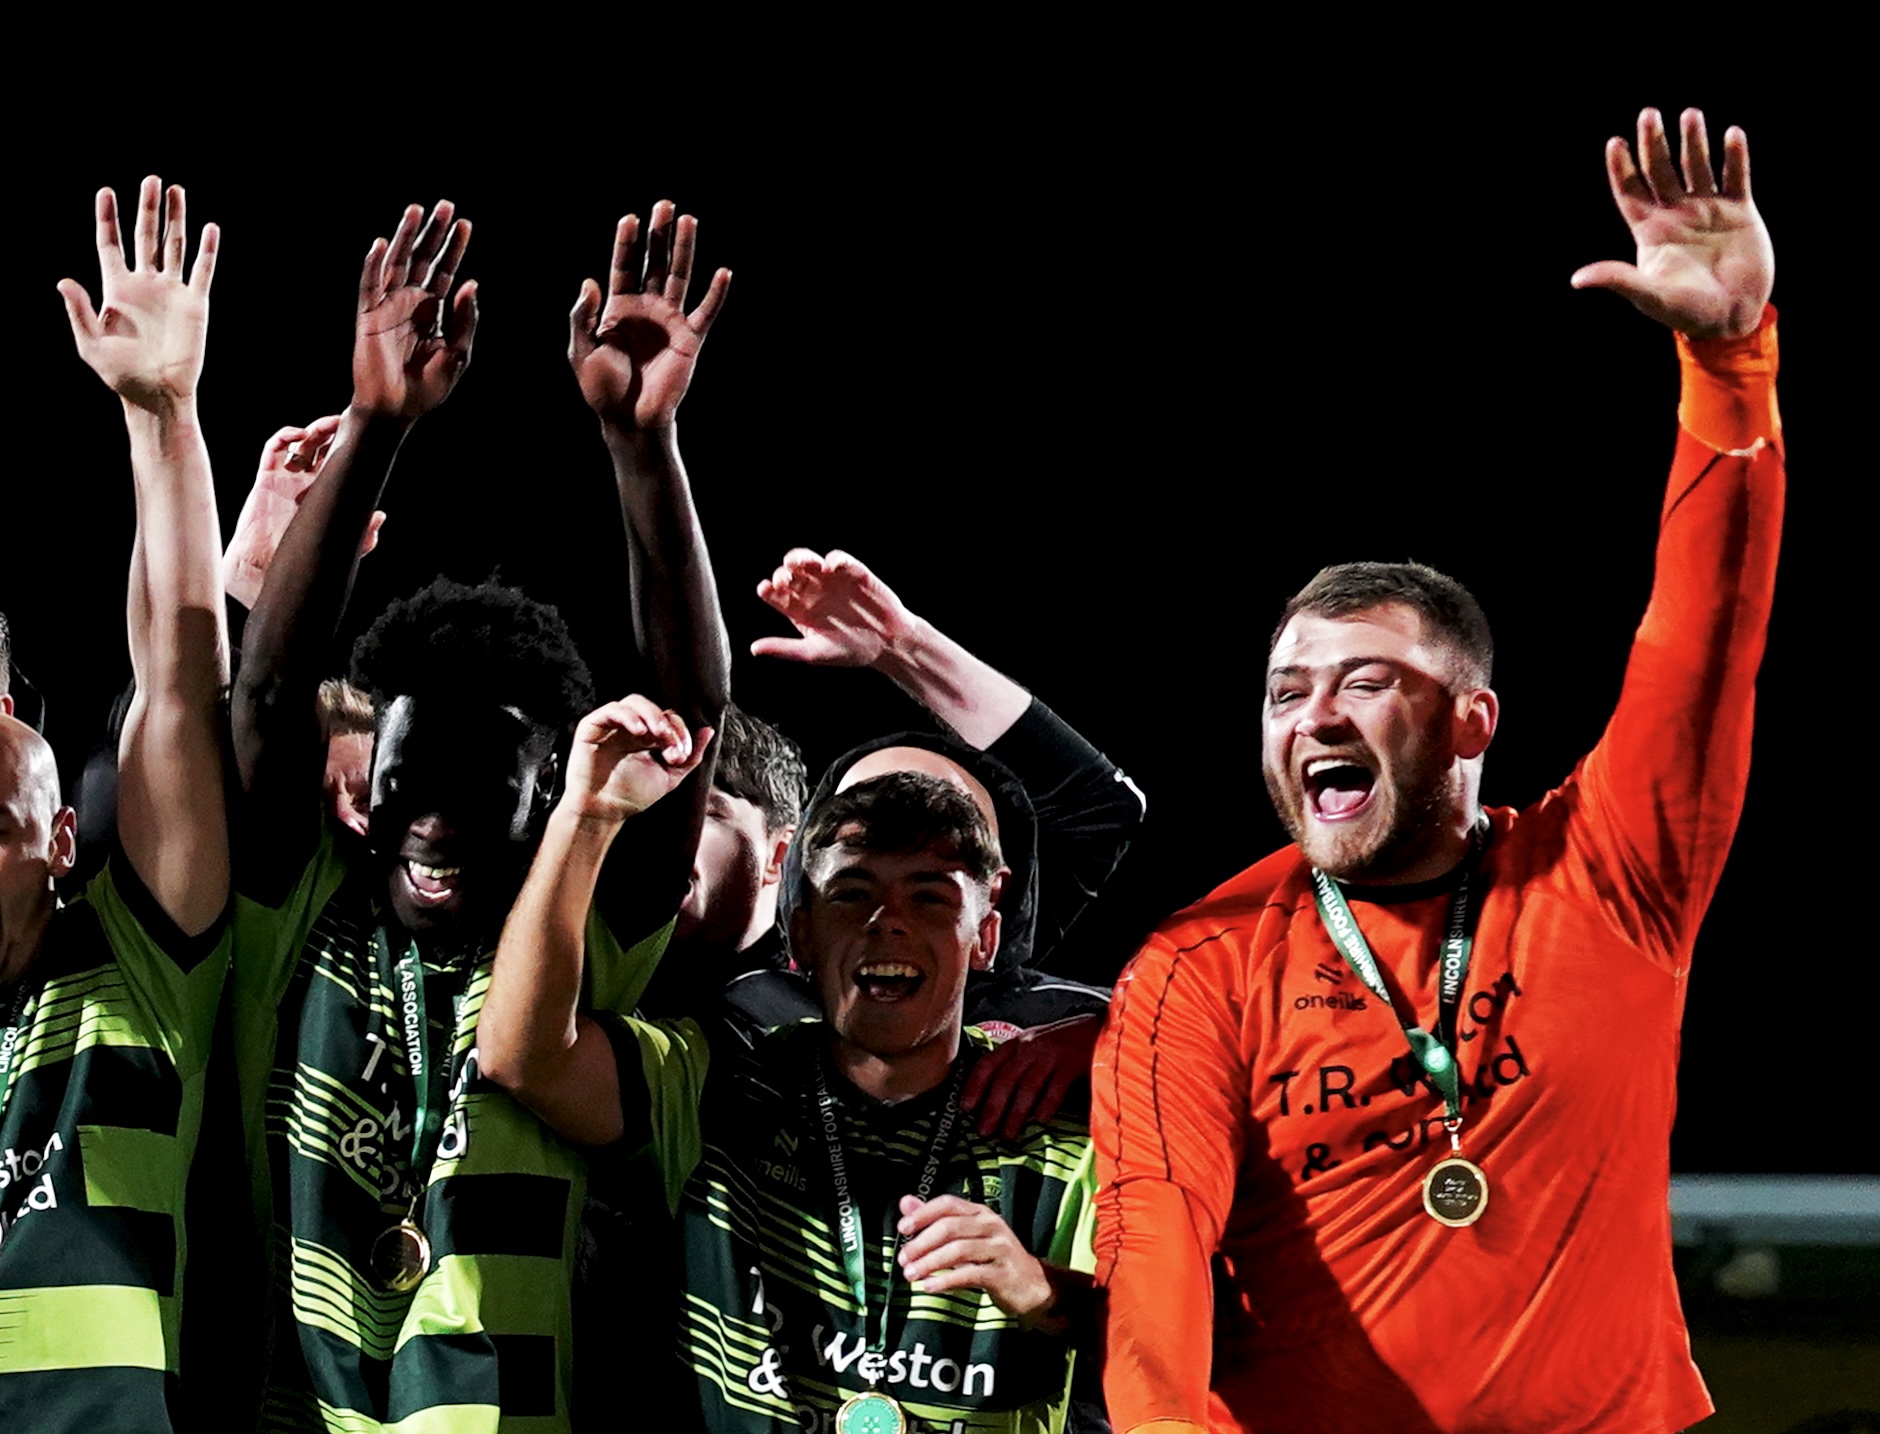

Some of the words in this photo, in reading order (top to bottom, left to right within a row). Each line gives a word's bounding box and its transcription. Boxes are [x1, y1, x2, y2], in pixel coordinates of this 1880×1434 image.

[1443, 894, 1469, 1005] LINCOLNSHIRE
[400, 970, 423, 1077] ASSOCIATION
[1269, 1065, 1372, 1116] T.R.
[340, 1118, 378, 1168] &
[827, 1143, 859, 1252] LINCOLNSHIRE
[748, 1348, 789, 1400] &
